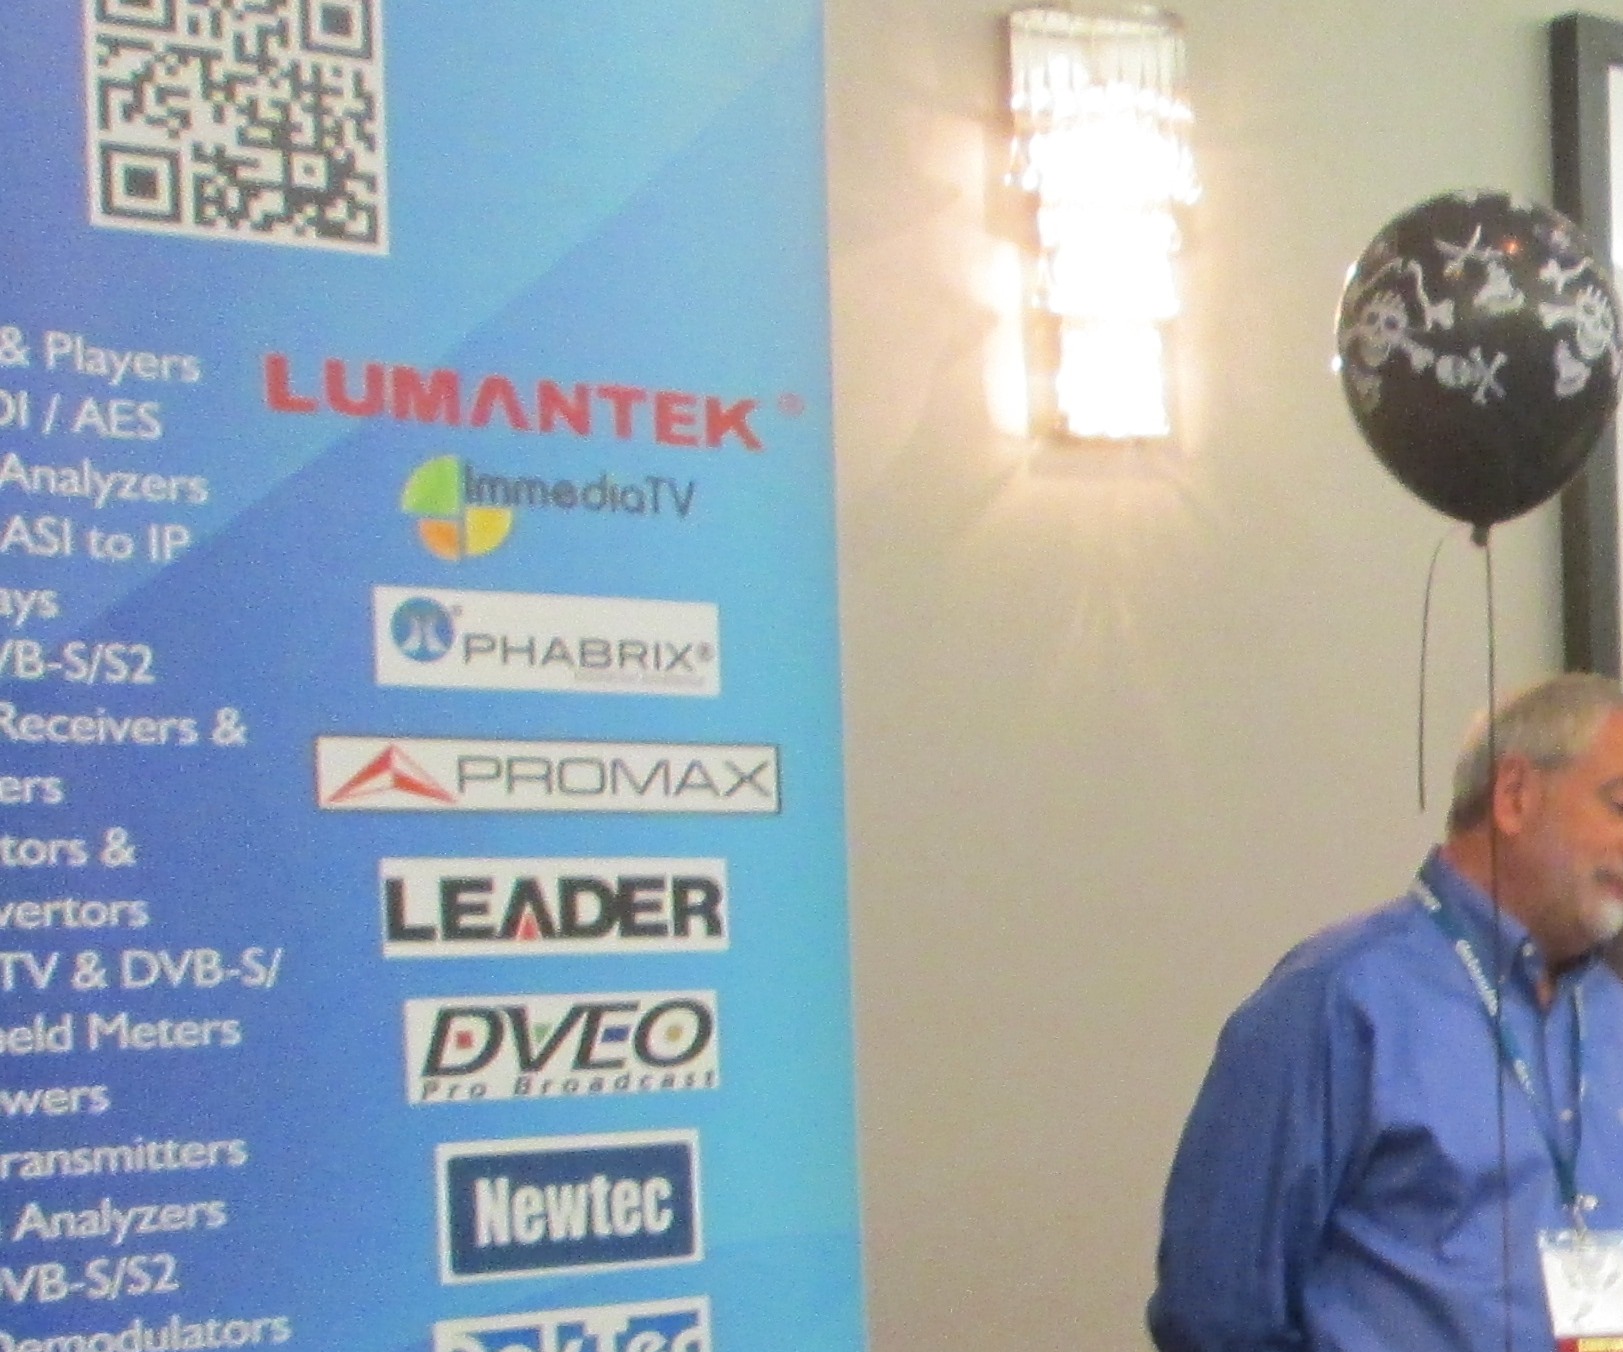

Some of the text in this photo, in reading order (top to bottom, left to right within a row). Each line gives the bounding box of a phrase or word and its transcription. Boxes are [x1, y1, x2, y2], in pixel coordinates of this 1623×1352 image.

[0, 326, 201, 385] & Players
[71, 397, 164, 440] AES
[264, 351, 764, 452] LUMANTEK
[0, 452, 209, 509] Analyzers
[1, 515, 191, 562] ASI to IP
[0, 702, 247, 745] Receivers &
[457, 755, 771, 798] PROMAX
[102, 826, 137, 867] &
[385, 875, 724, 941] LEADER
[72, 950, 107, 990] &
[121, 947, 283, 989] DVB-S/
[88, 1011, 242, 1051] Meters
[422, 997, 714, 1077] DVEO
[422, 1070, 718, 1100] Pro Broadcast
[12, 1198, 227, 1246] Analyzers
[474, 1174, 673, 1248] Newtec
